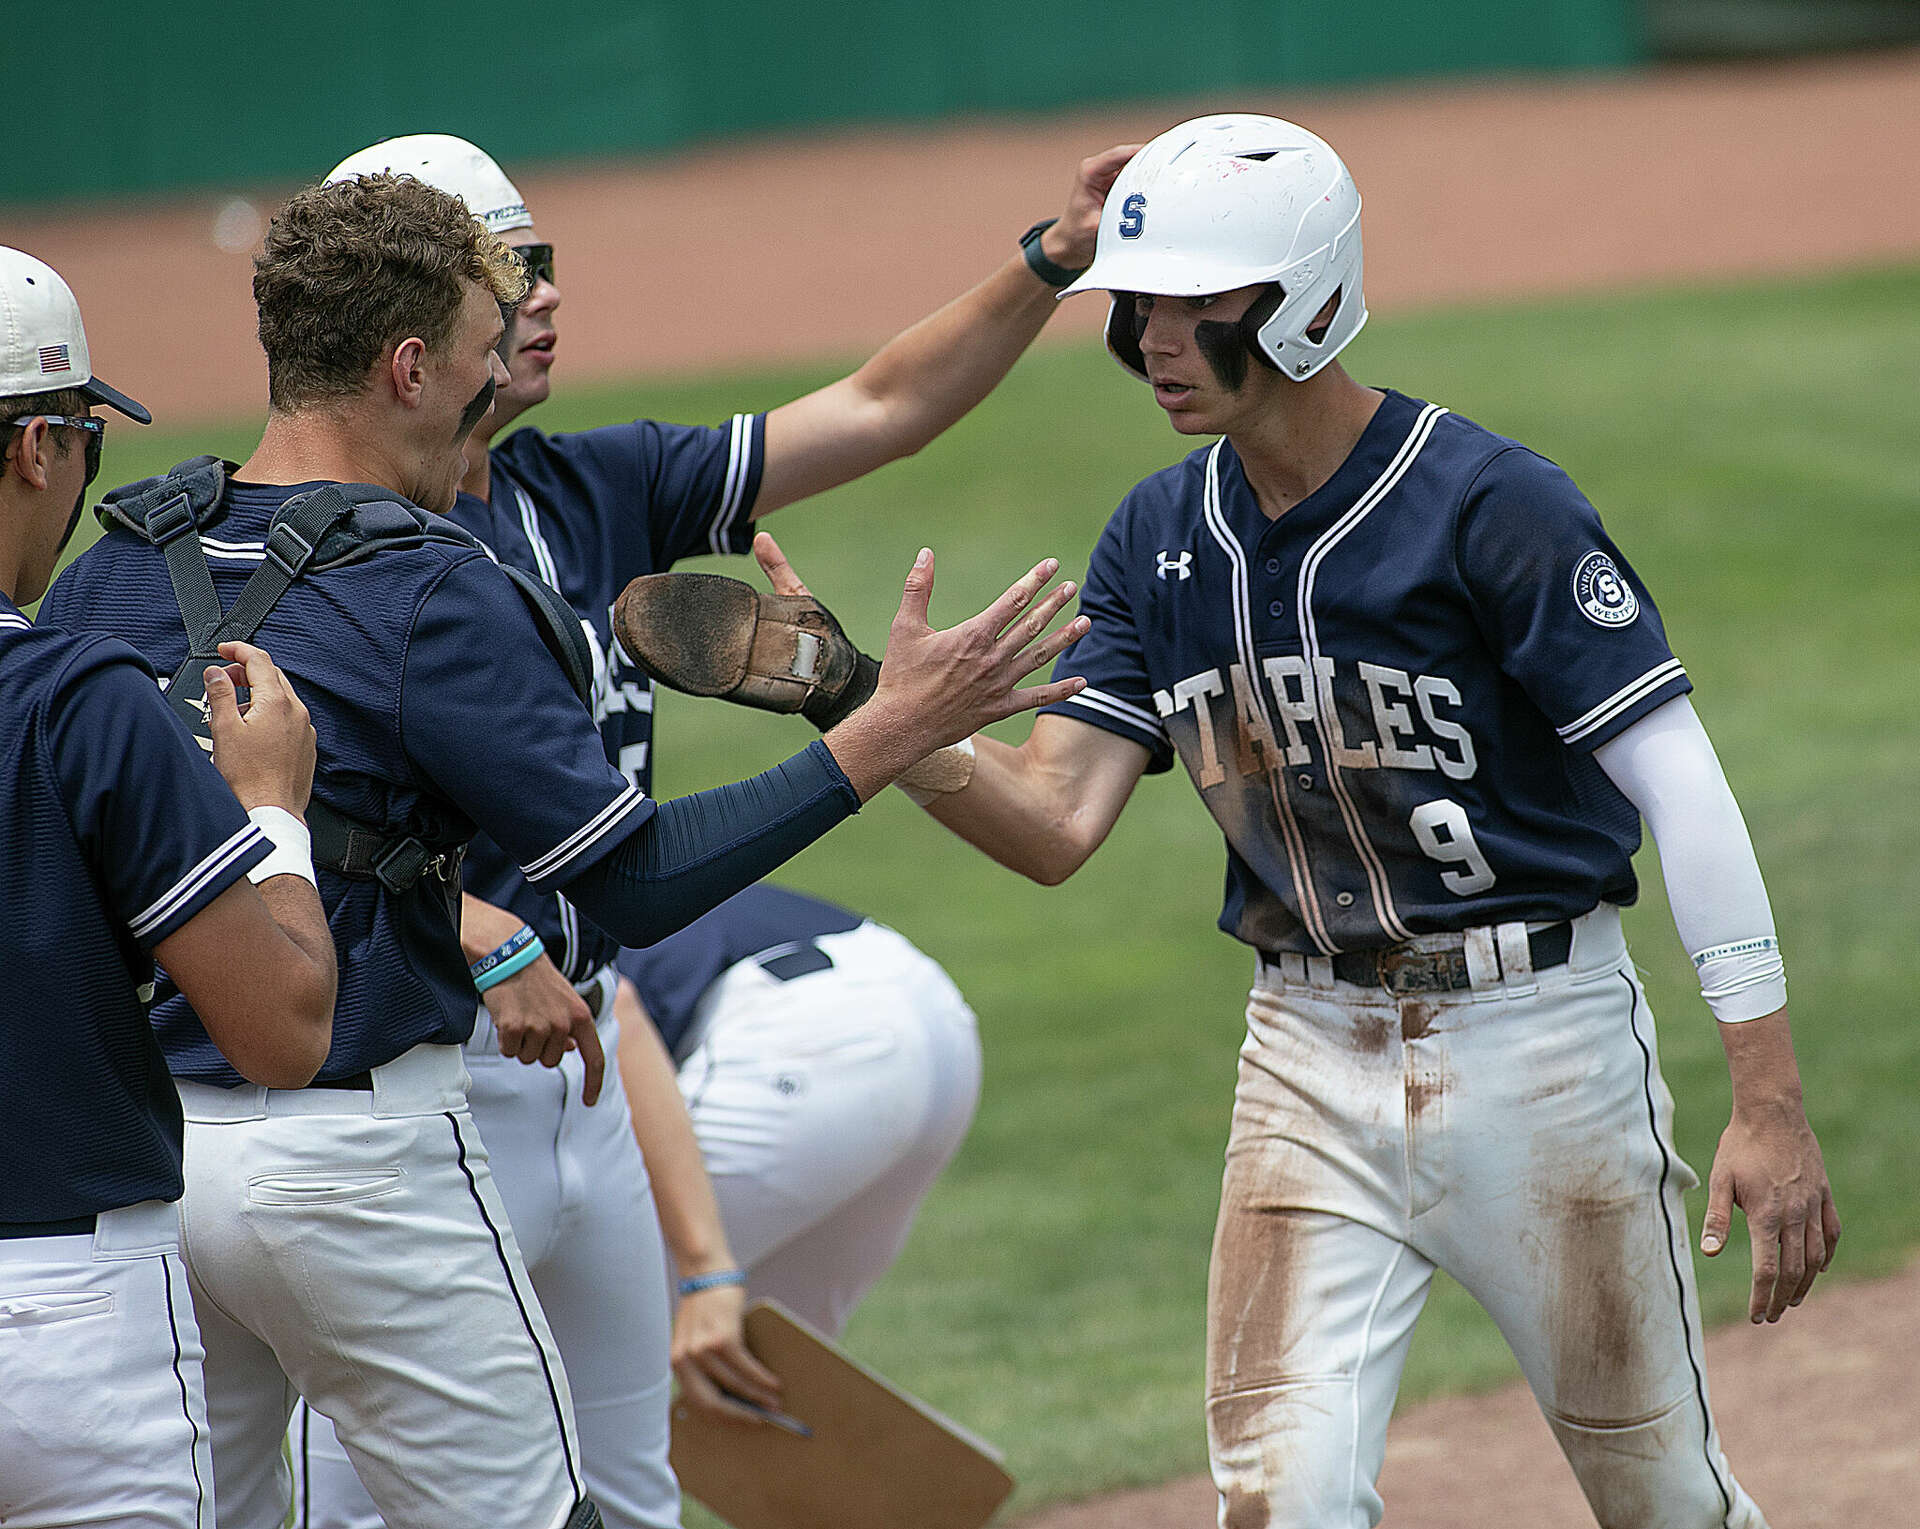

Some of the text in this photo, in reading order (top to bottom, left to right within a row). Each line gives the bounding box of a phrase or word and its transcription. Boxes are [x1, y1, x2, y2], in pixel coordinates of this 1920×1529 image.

[1119, 193, 1148, 240] S
[1598, 574, 1622, 603] S
[1409, 798, 1497, 897] 9
